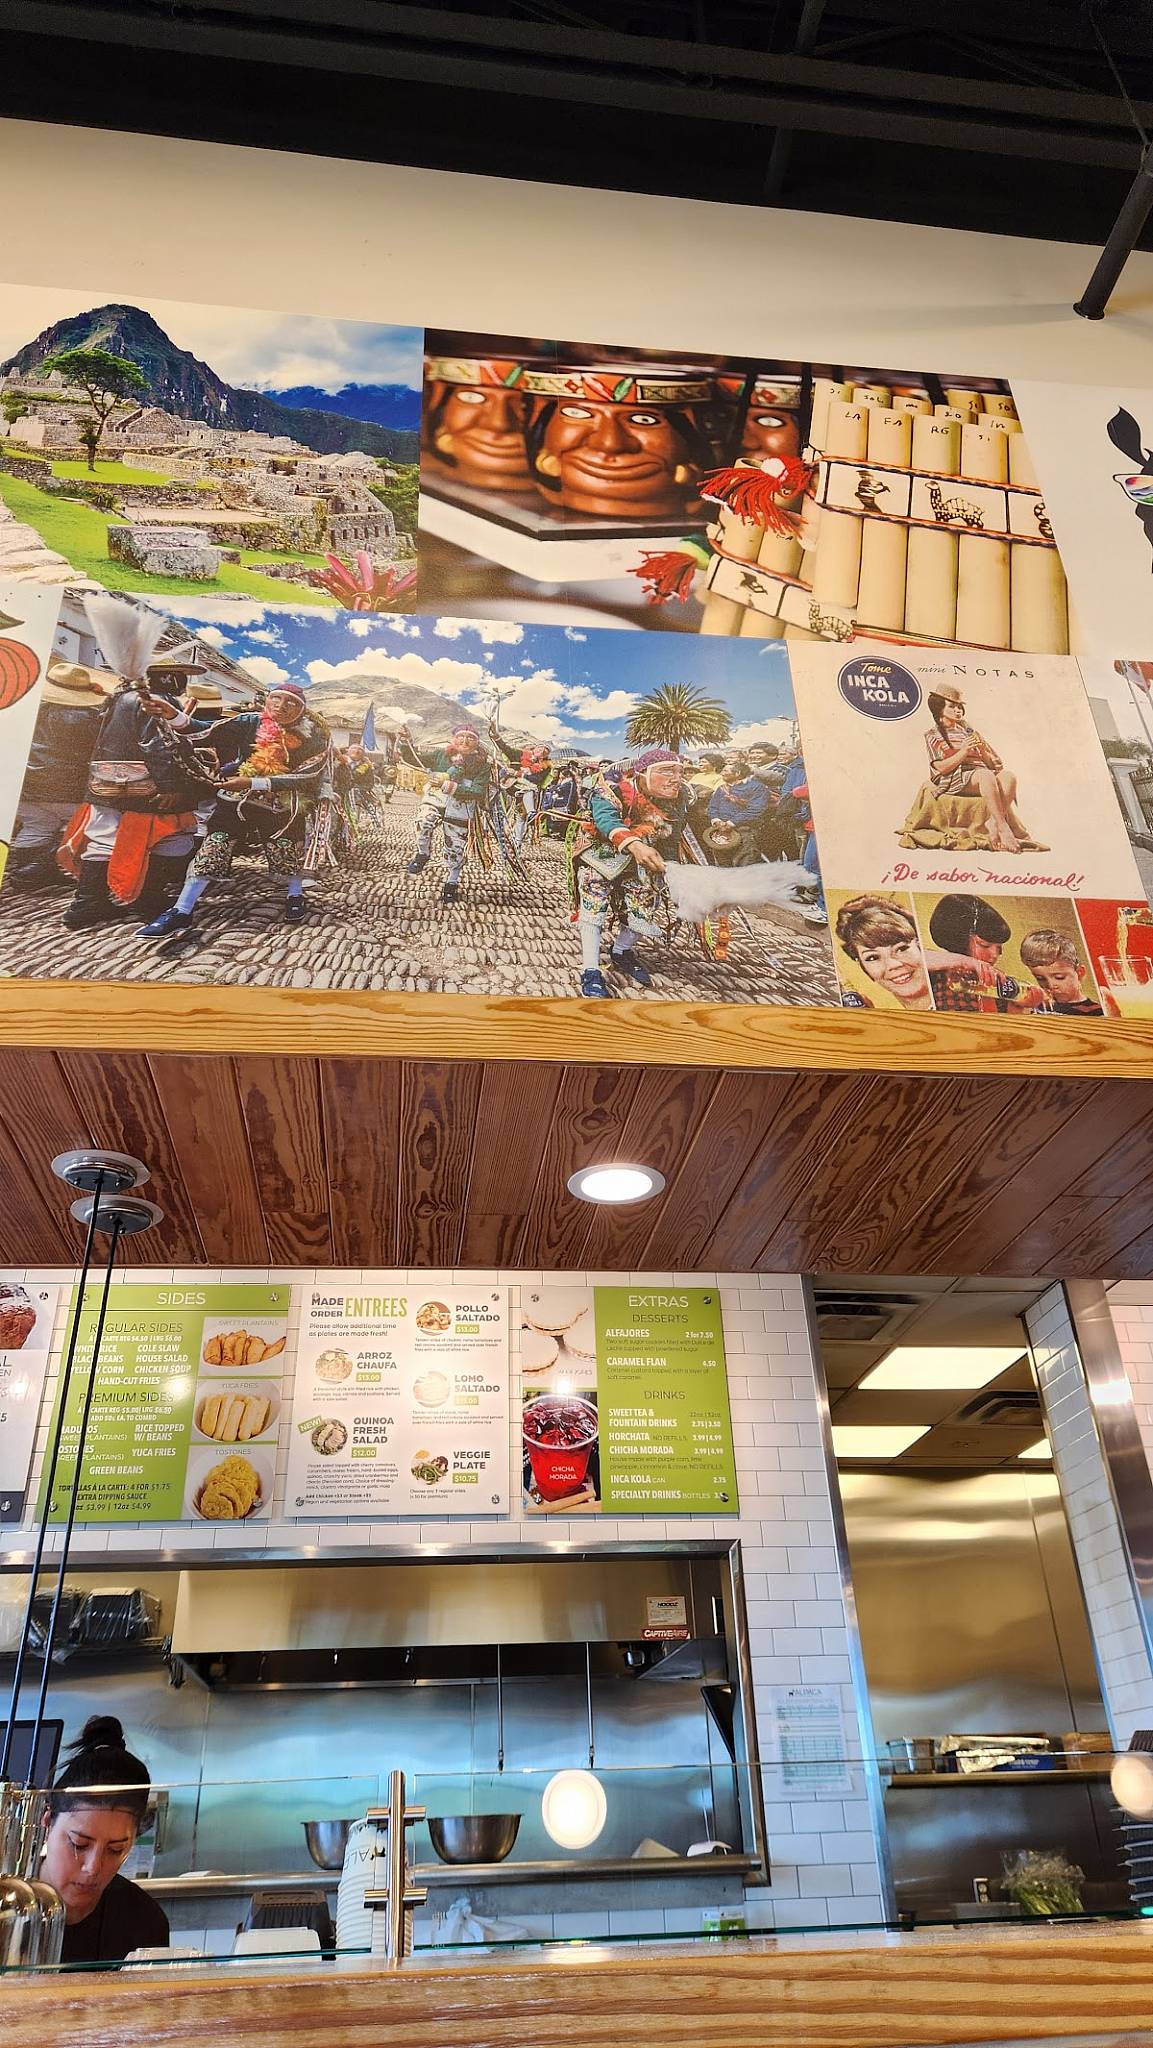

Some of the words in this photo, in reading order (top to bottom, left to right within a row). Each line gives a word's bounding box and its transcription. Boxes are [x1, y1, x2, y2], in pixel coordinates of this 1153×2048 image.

[860, 662, 892, 674] Tome
[917, 663, 948, 674] mini
[953, 665, 1035, 679] NOTAS
[847, 674, 890, 689] INCA
[862, 688, 911, 704] KOLA
[881, 862, 919, 884] ¡De
[926, 867, 979, 884] sabor
[977, 866, 1085, 892] nacional!
[156, 1292, 207, 1305] SIDES
[311, 1297, 344, 1306] MADE
[628, 1295, 689, 1308] EXTRAS
[345, 1297, 408, 1317] ENTREES
[455, 1305, 489, 1313] POLLO
[310, 1310, 343, 1318] ORDER
[455, 1314, 500, 1322] SALTADO
[632, 1314, 689, 1324] DESSERTS
[89, 1322, 146, 1333] RGULAR
[149, 1322, 183, 1333] SIDES
[605, 1328, 650, 1338] ALFAJORES
[75, 1344, 96, 1353] WHIT
[137, 1344, 157, 1353] COLE
[158, 1344, 180, 1352] SLAW
[72, 1355, 94, 1363] BLAC
[135, 1355, 162, 1363] HOUSE
[163, 1354, 189, 1363] SALAD
[356, 1352, 393, 1360] ARROZ
[356, 1361, 397, 1369] CHAUFA
[606, 1357, 646, 1367] CARAMEL
[646, 1357, 667, 1367] FLAN
[102, 1365, 125, 1374] CORN
[134, 1365, 170, 1374] CHICKEN
[170, 1365, 192, 1374] SOUP
[97, 1376, 139, 1385] HAND-CUT
[140, 1376, 160, 1385] FRIES
[454, 1375, 484, 1383] LOMO
[454, 1385, 501, 1393] SALTADO
[78, 1392, 137, 1403] PEMIUM
[139, 1392, 174, 1402] SIDES
[644, 1390, 686, 1400] DRINKS
[608, 1408, 635, 1417] SWEET
[634, 1408, 648, 1417] TEA
[648, 1408, 654, 1417] &
[353, 1417, 395, 1425] QUINOA
[609, 1419, 648, 1427] FOUNTAIN
[648, 1419, 678, 1427] DRINKS
[134, 1424, 153, 1433] RICE
[154, 1423, 185, 1432] TOPPED
[352, 1426, 386, 1435] FRESH
[133, 1433, 144, 1441] W/
[146, 1432, 173, 1441] BEANS
[352, 1436, 388, 1444] SALAD
[608, 1432, 650, 1441] HORCHATA
[132, 1448, 153, 1457] YUCA
[154, 1448, 177, 1457] FRIES
[453, 1451, 491, 1459] VEGGIE
[609, 1446, 640, 1455] CHICHA
[640, 1446, 674, 1455] MORADA
[452, 1461, 486, 1470] PLATE
[89, 1466, 116, 1475] GREEN
[117, 1466, 144, 1474] BEANS
[610, 1474, 630, 1484] INCA
[630, 1474, 652, 1484] KOLA
[77, 1493, 97, 1501] EXTRA
[98, 1493, 125, 1501] DIPPING
[611, 1490, 651, 1500] SPECIALTY
[651, 1490, 682, 1499] DRINKS
